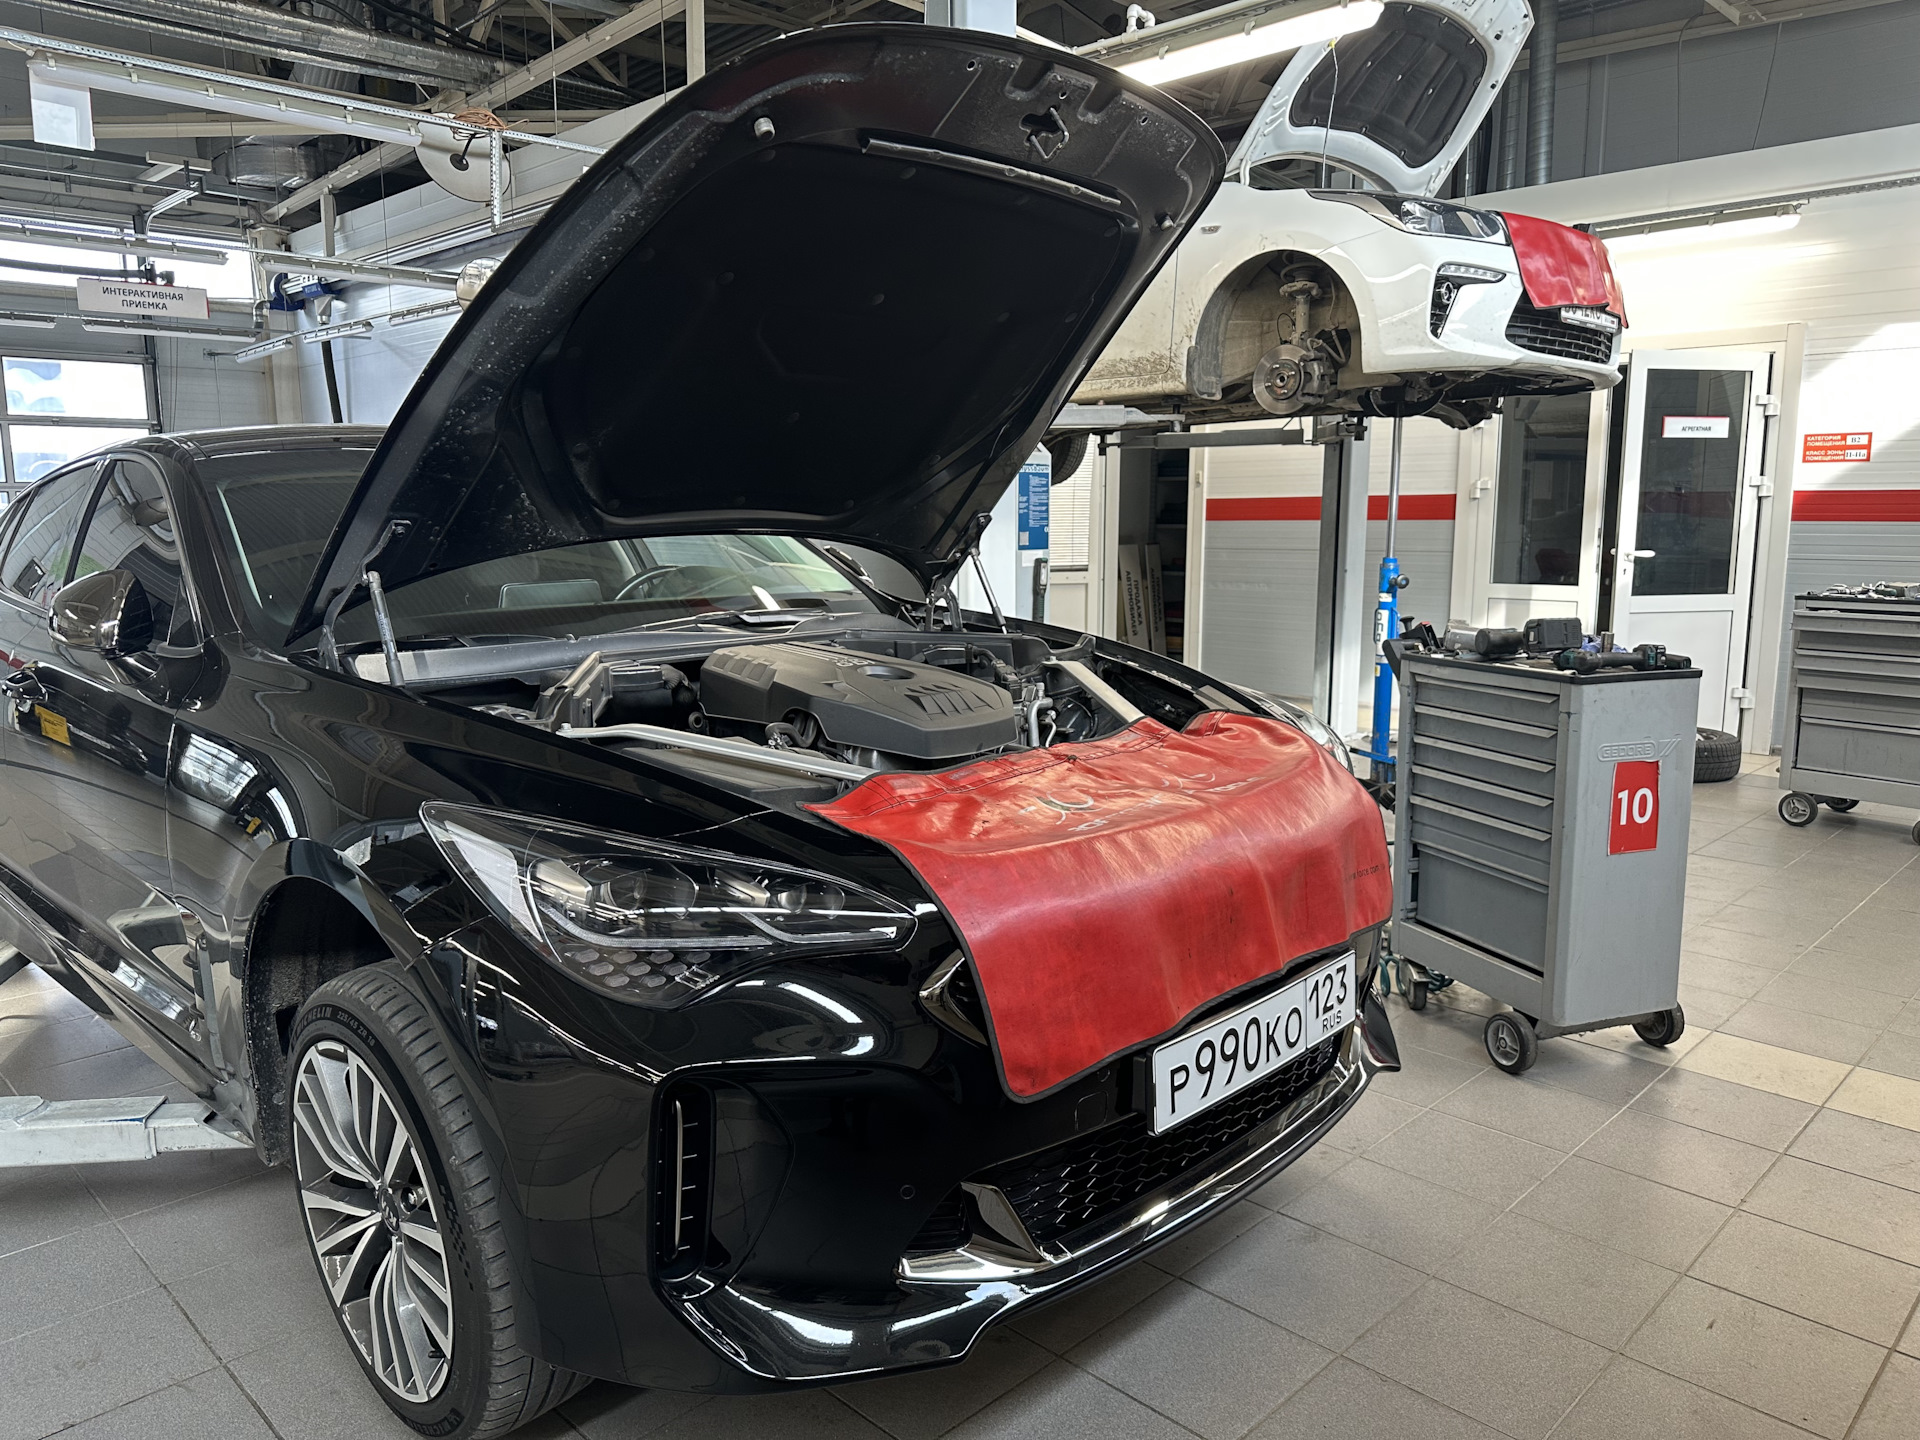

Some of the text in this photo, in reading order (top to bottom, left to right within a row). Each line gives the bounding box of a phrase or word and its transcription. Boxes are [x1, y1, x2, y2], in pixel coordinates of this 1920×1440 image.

[102, 286, 184, 301] ИНТЕРАКТИВНАЯ
[121, 299, 168, 311] ПРИЕМКА
[1125, 570, 1138, 637] АВТОМОБИЛЕЙ
[1133, 580, 1143, 626] ПРОДАЖА
[1617, 787, 1654, 826] 10
[1308, 964, 1348, 1019] 123
[296, 1006, 376, 1047] MICHELIN 225/45 ZR 18
[1321, 1011, 1343, 1034] RUS
